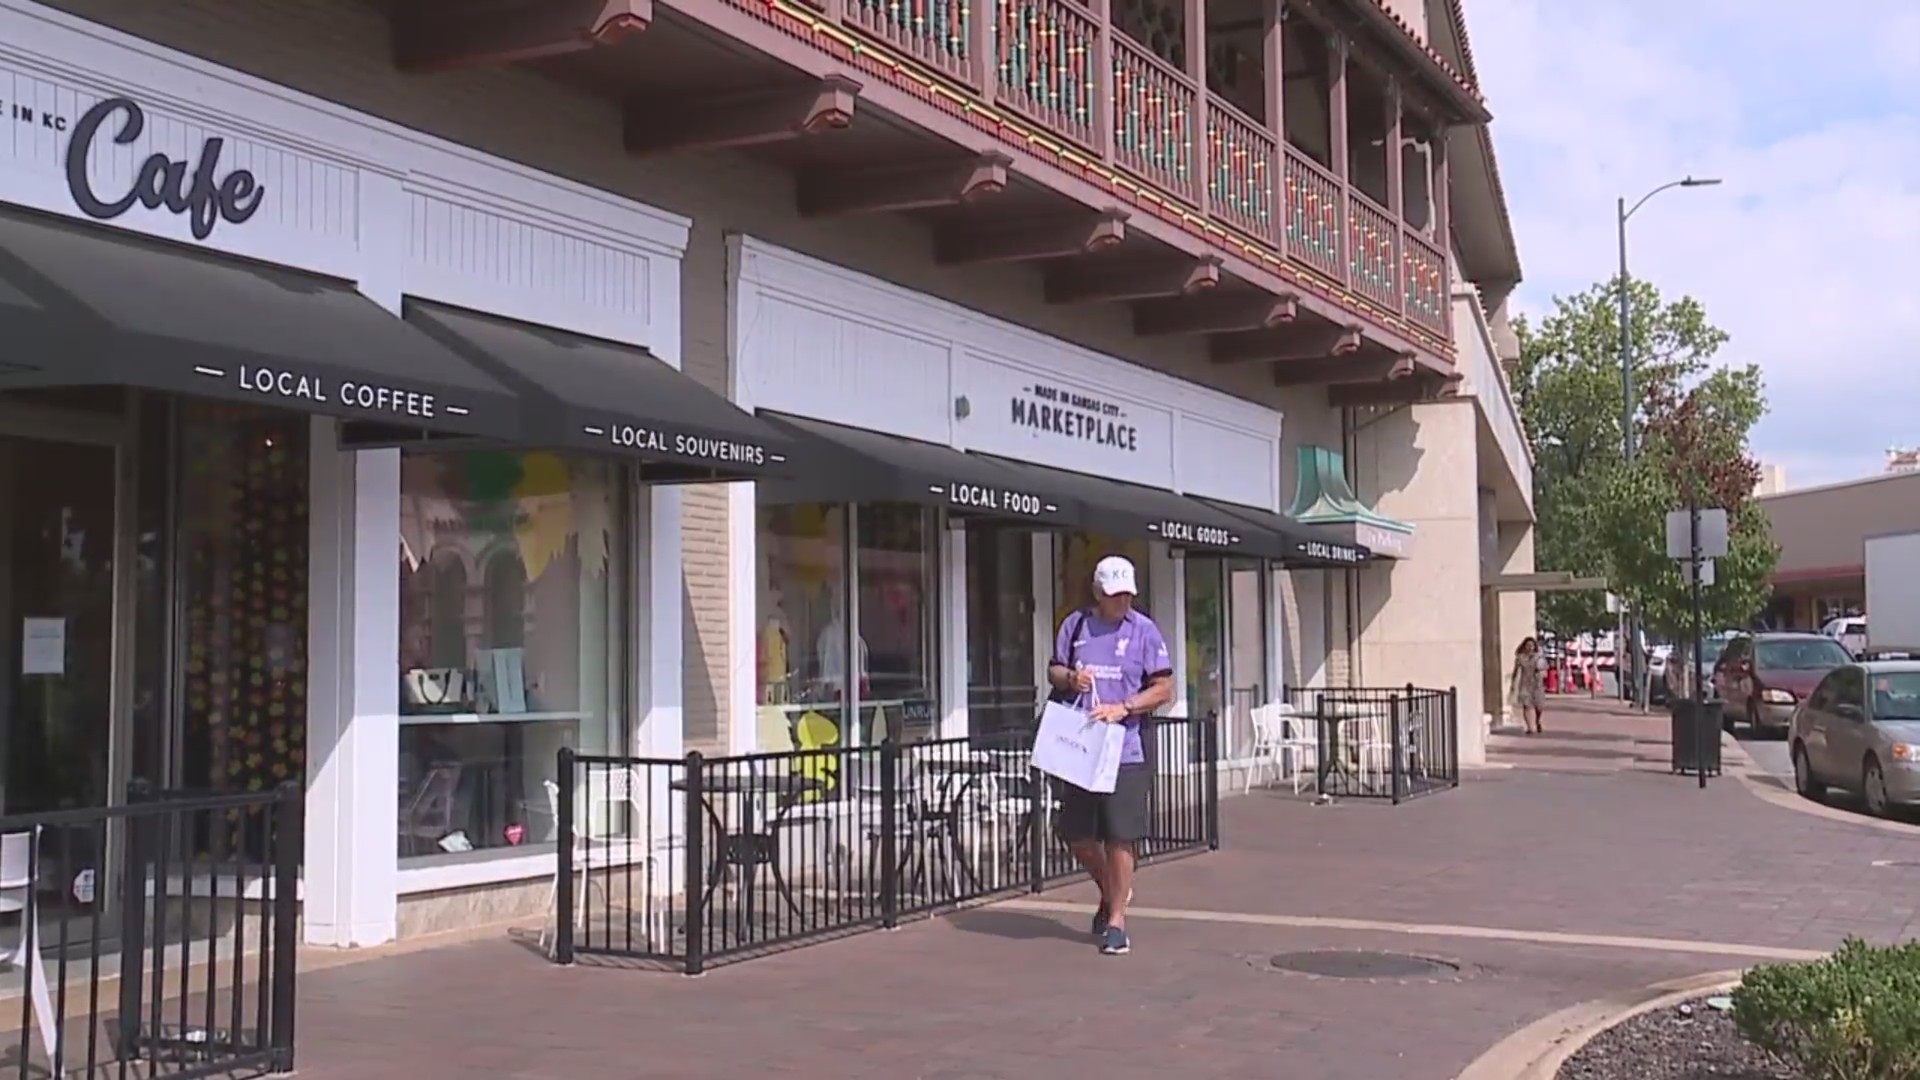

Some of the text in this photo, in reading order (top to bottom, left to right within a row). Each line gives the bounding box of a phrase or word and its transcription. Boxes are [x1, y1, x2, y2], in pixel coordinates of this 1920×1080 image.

[12, 103, 33, 122] IN
[42, 112, 67, 131] KC
[66, 97, 265, 240] Cafe
[239, 364, 435, 418] LOCAL COFFEE
[1034, 384, 1120, 418] MADE IN KANSAS CITY
[1011, 397, 1137, 451] MARKETPLACE
[611, 425, 765, 465] LOCAL SOUVENIRS
[951, 482, 1040, 515] LOCAL FOOD
[1161, 521, 1229, 546] LOCAL GOODS
[1307, 542, 1357, 563] LOCAL DRINKS
